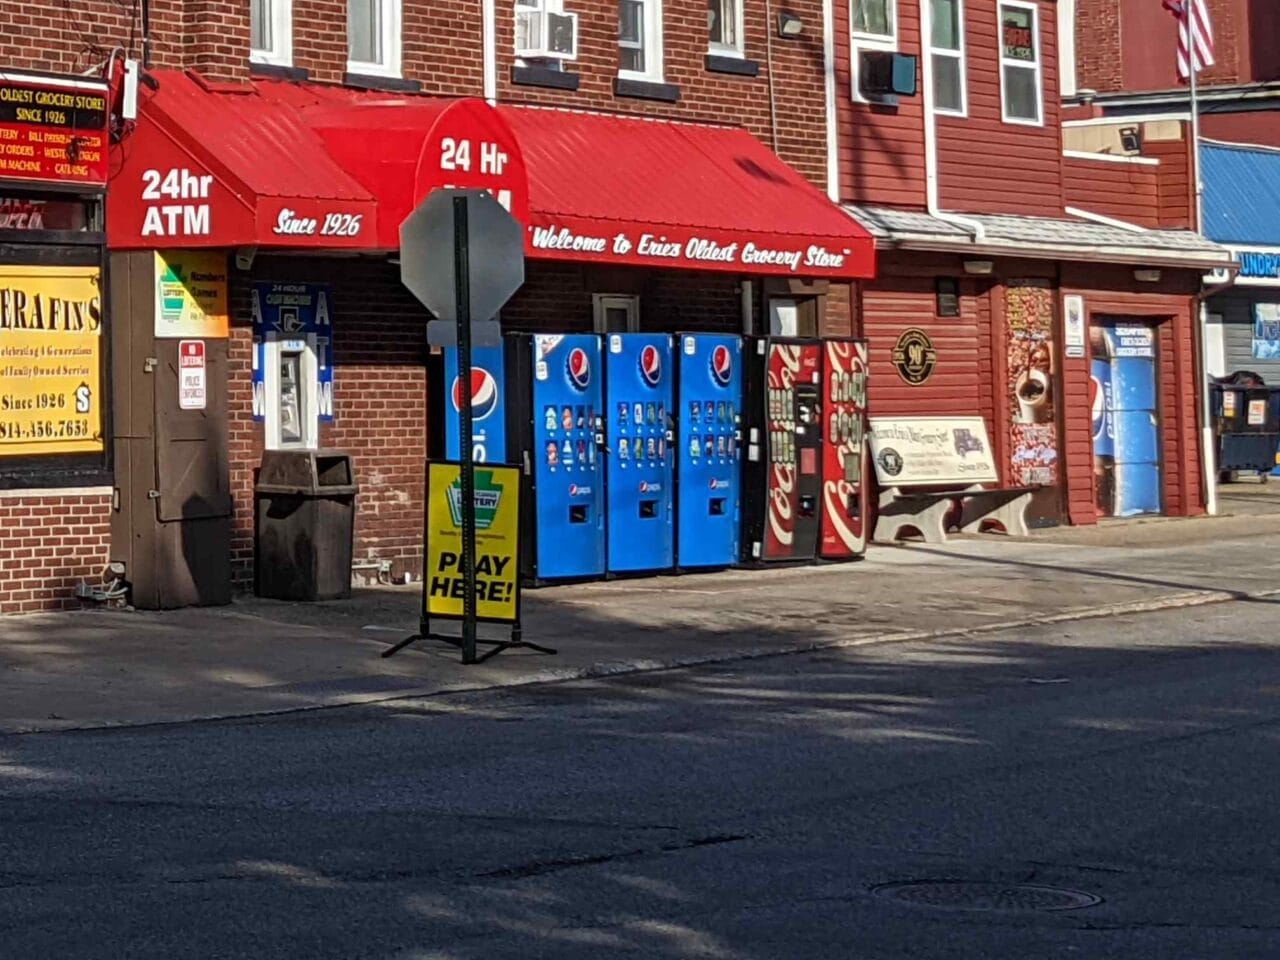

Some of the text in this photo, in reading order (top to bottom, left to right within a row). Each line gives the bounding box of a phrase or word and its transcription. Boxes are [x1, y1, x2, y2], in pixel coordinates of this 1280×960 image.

[0, 88, 34, 103] OLDEST
[35, 91, 75, 108] GROCERY
[16, 107, 66, 124] SINCE 1926
[28, 131, 43, 142] BILL
[6, 145, 35, 157] ORDERS
[440, 136, 508, 175] 24 Hr
[141, 168, 214, 201] 24hr
[141, 204, 210, 237] ATM
[272, 207, 364, 237] Since 1926
[613, 233, 633, 255] to
[684, 237, 738, 262] Oldest
[741, 242, 803, 271] Grocery
[1, 393, 33, 411] Since
[36, 392, 65, 409] 1926
[457, 495, 497, 507] LTERY
